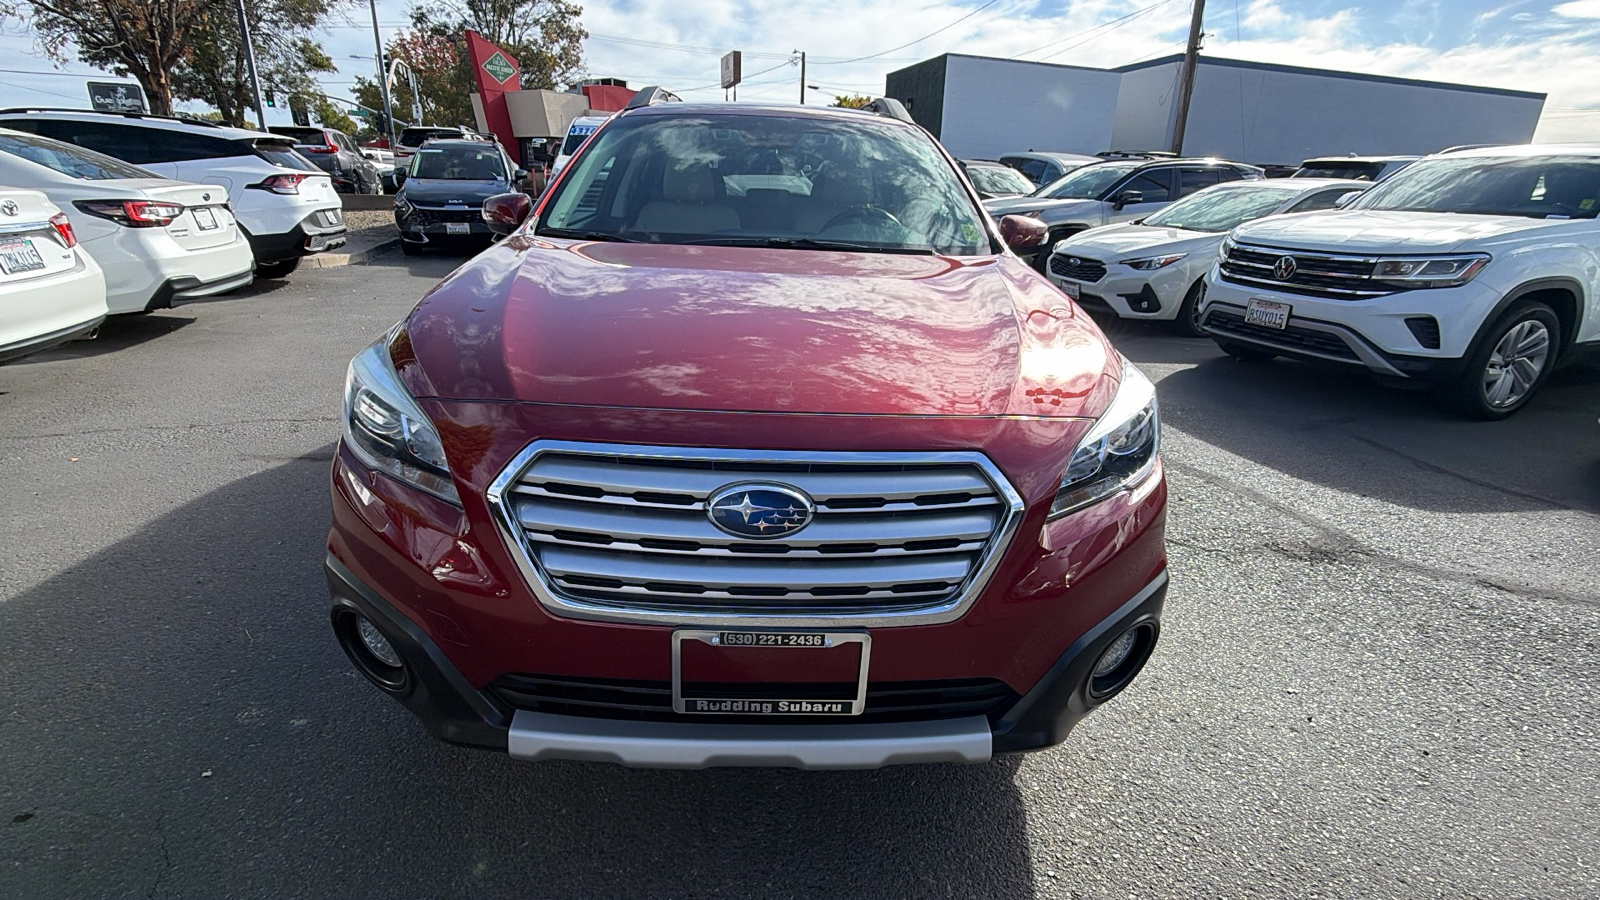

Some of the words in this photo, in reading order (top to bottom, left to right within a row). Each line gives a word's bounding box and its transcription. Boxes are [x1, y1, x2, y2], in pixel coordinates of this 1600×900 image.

[1249, 308, 1284, 325] 8SUY015
[723, 633, 757, 645] (530)
[759, 634, 822, 646] 221-2436
[696, 700, 772, 713] Redding
[778, 701, 842, 713] Subaru
